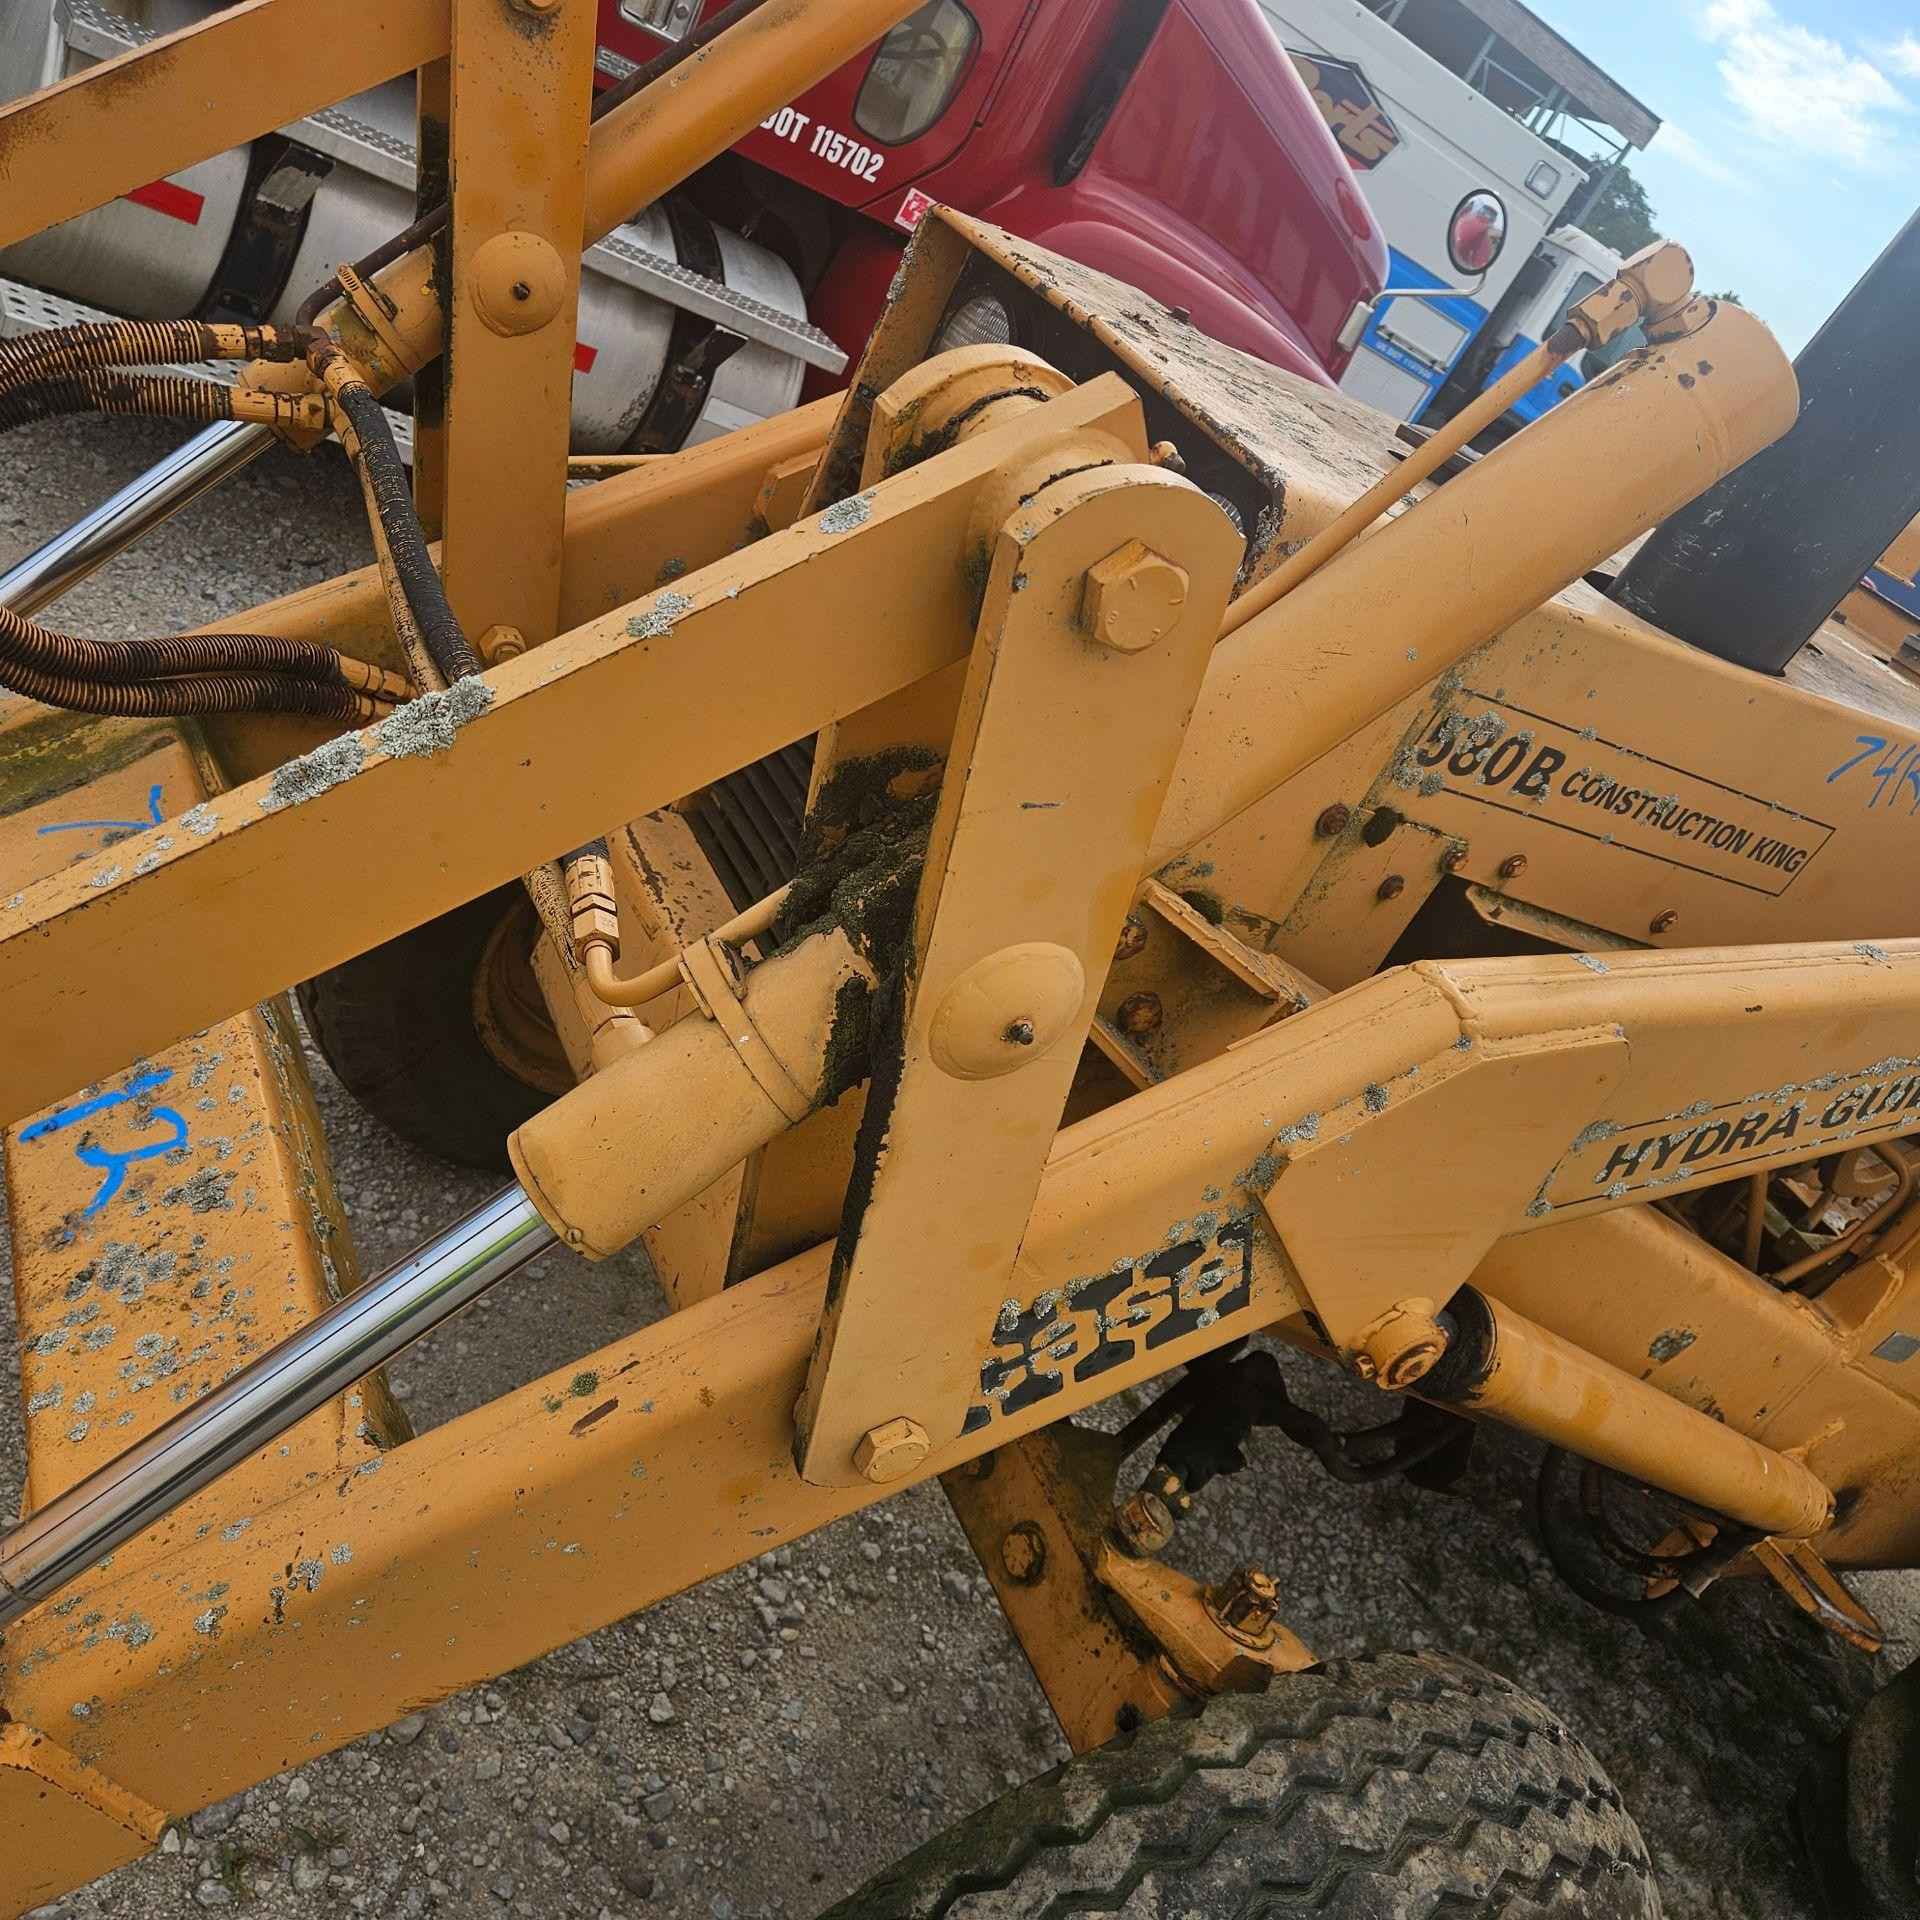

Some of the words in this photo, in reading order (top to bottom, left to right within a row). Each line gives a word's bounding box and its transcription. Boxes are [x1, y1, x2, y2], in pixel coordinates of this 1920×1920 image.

[810, 125, 885, 183] 115702
[1416, 713, 1566, 797] 580B
[1560, 769, 1754, 855] CONSTRUCTION
[1746, 836, 1808, 874] KING
